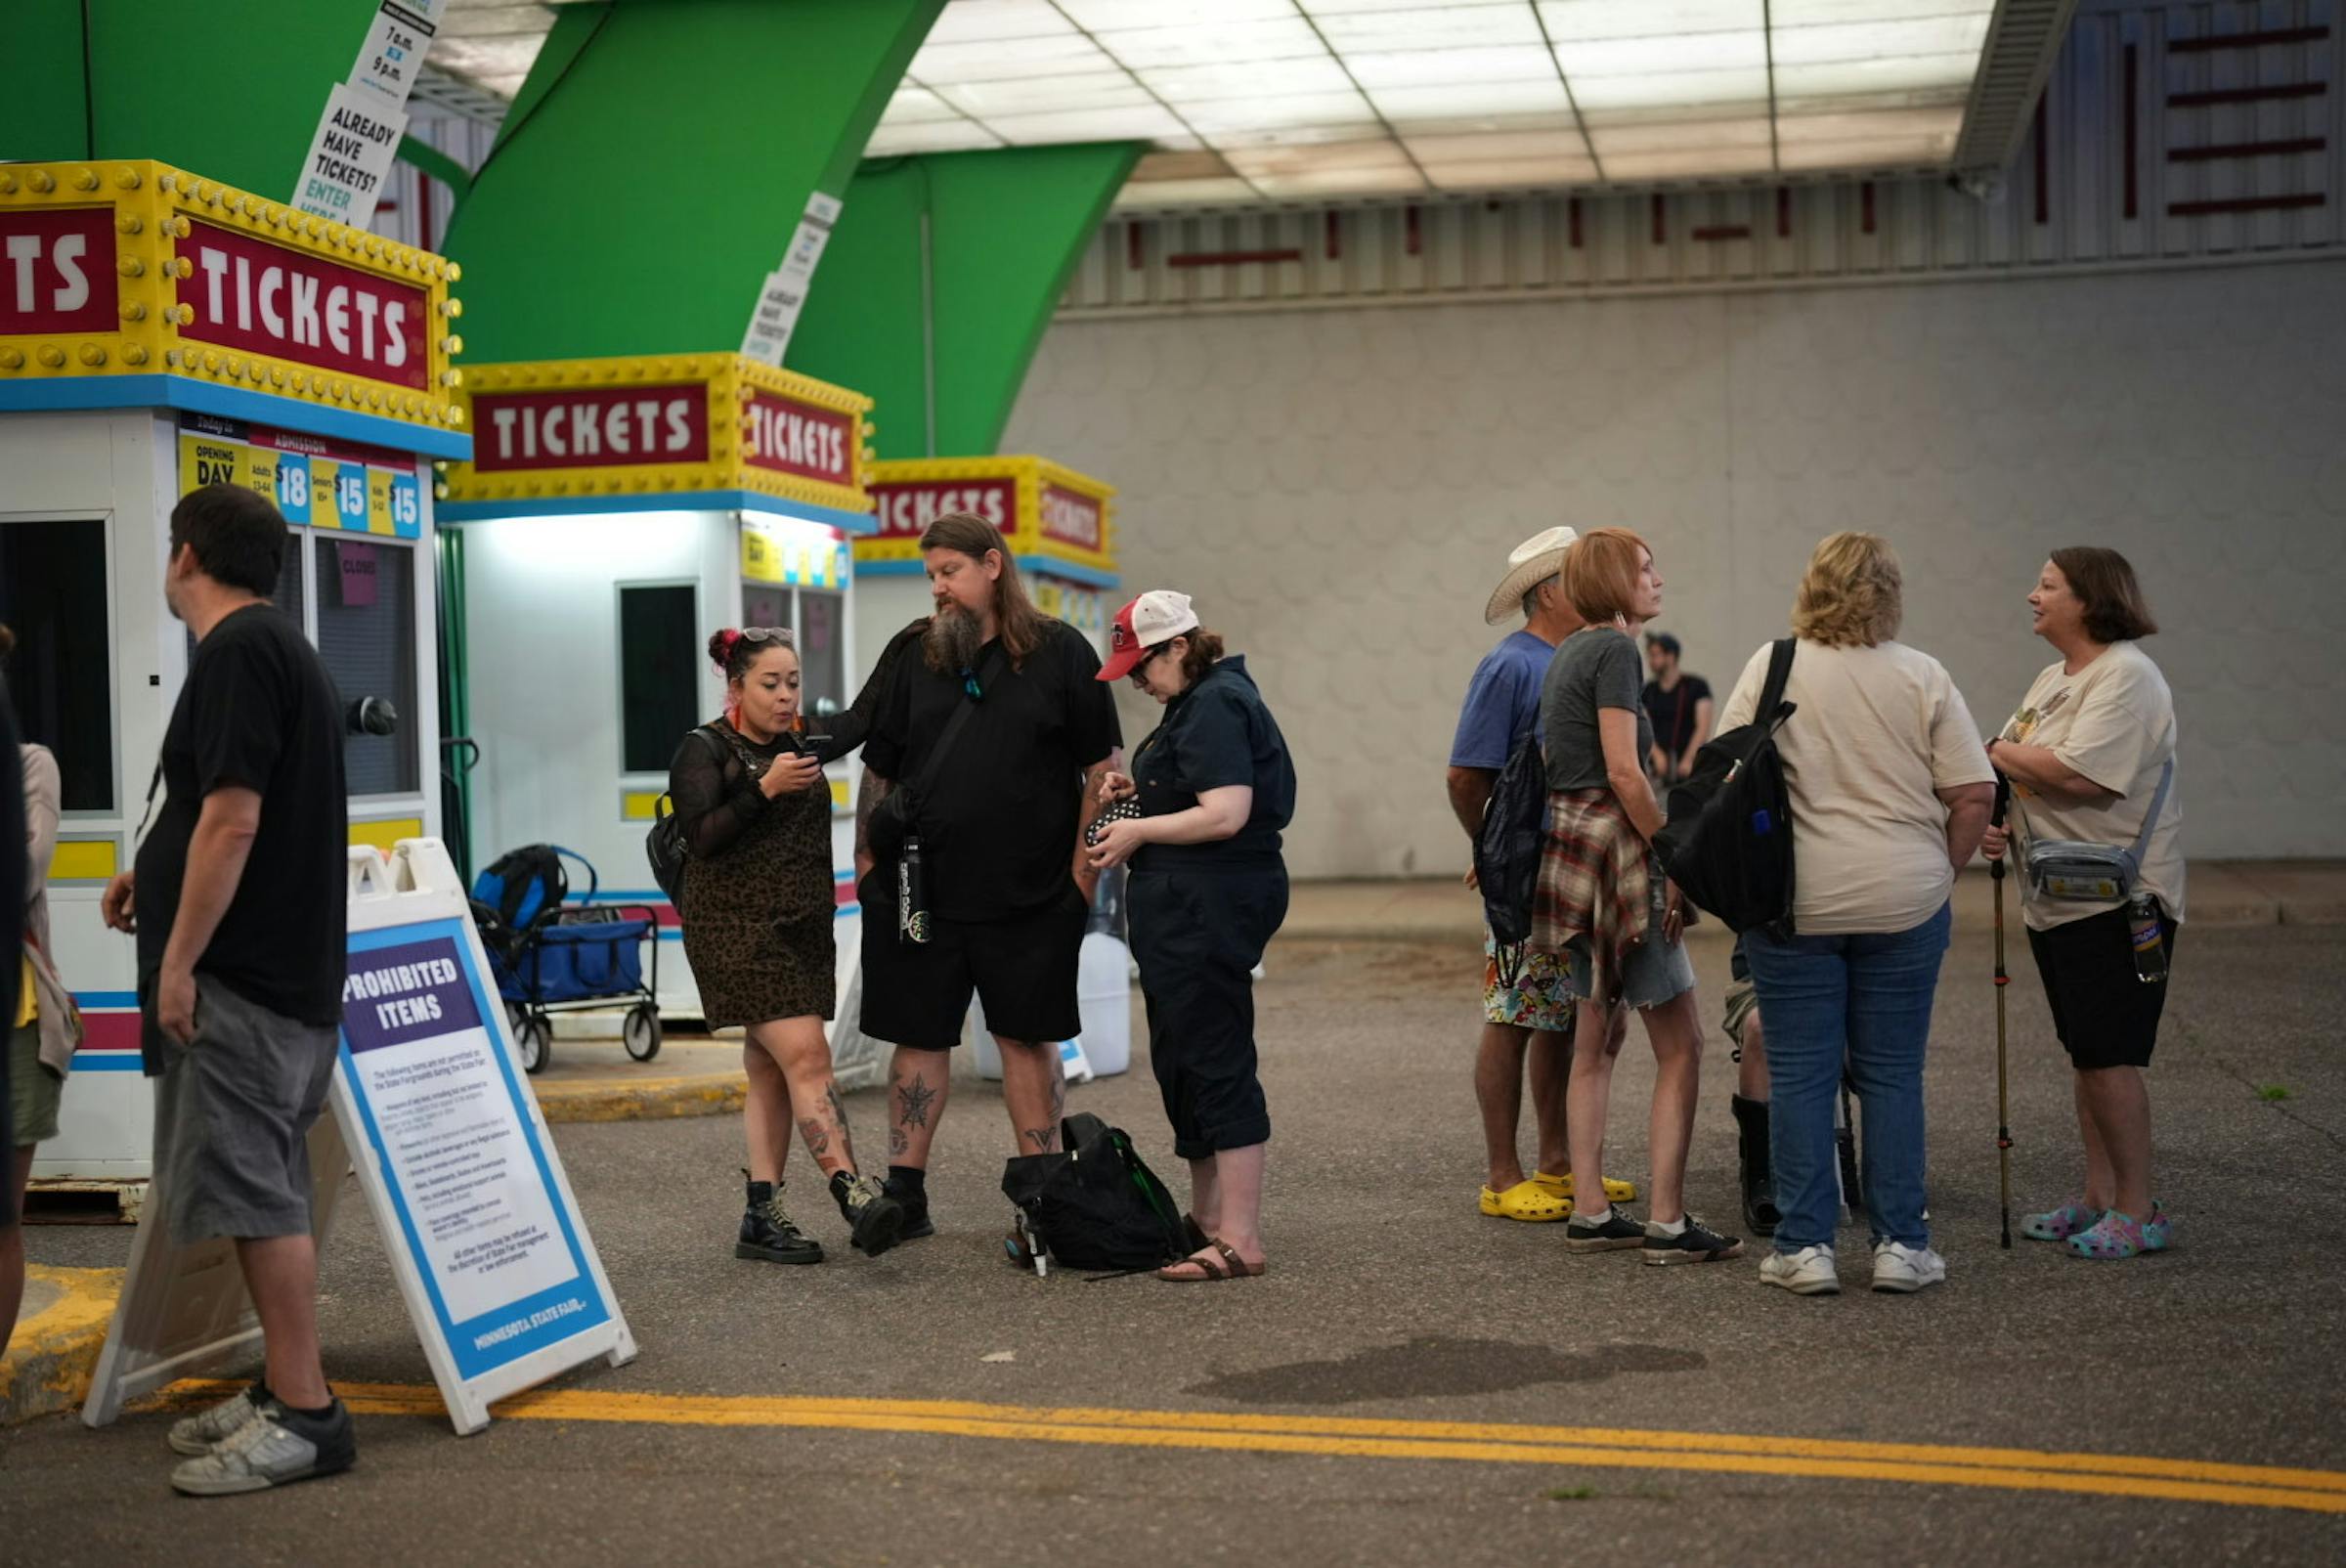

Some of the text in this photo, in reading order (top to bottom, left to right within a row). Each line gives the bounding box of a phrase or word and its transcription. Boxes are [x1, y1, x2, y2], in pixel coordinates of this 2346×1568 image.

[386, 26, 395, 41] 7
[373, 56, 382, 70] 9
[323, 129, 363, 160] HAVE
[331, 107, 395, 147] ALREADY
[306, 178, 351, 209] ENTER
[316, 153, 377, 194] TICKETS?
[200, 246, 407, 368] TICKETS
[275, 434, 326, 455] ADMISSION
[494, 399, 691, 459] TICKETS
[748, 404, 844, 474] TICKETS
[196, 446, 235, 462] OPENING
[197, 459, 234, 486] DAY
[276, 463, 308, 507] $18
[334, 473, 364, 516] $15
[389, 484, 416, 525] $15
[375, 994, 443, 1030] ITEMS
[474, 1318, 533, 1351] MINNESOTA
[530, 1308, 560, 1328] STATE
